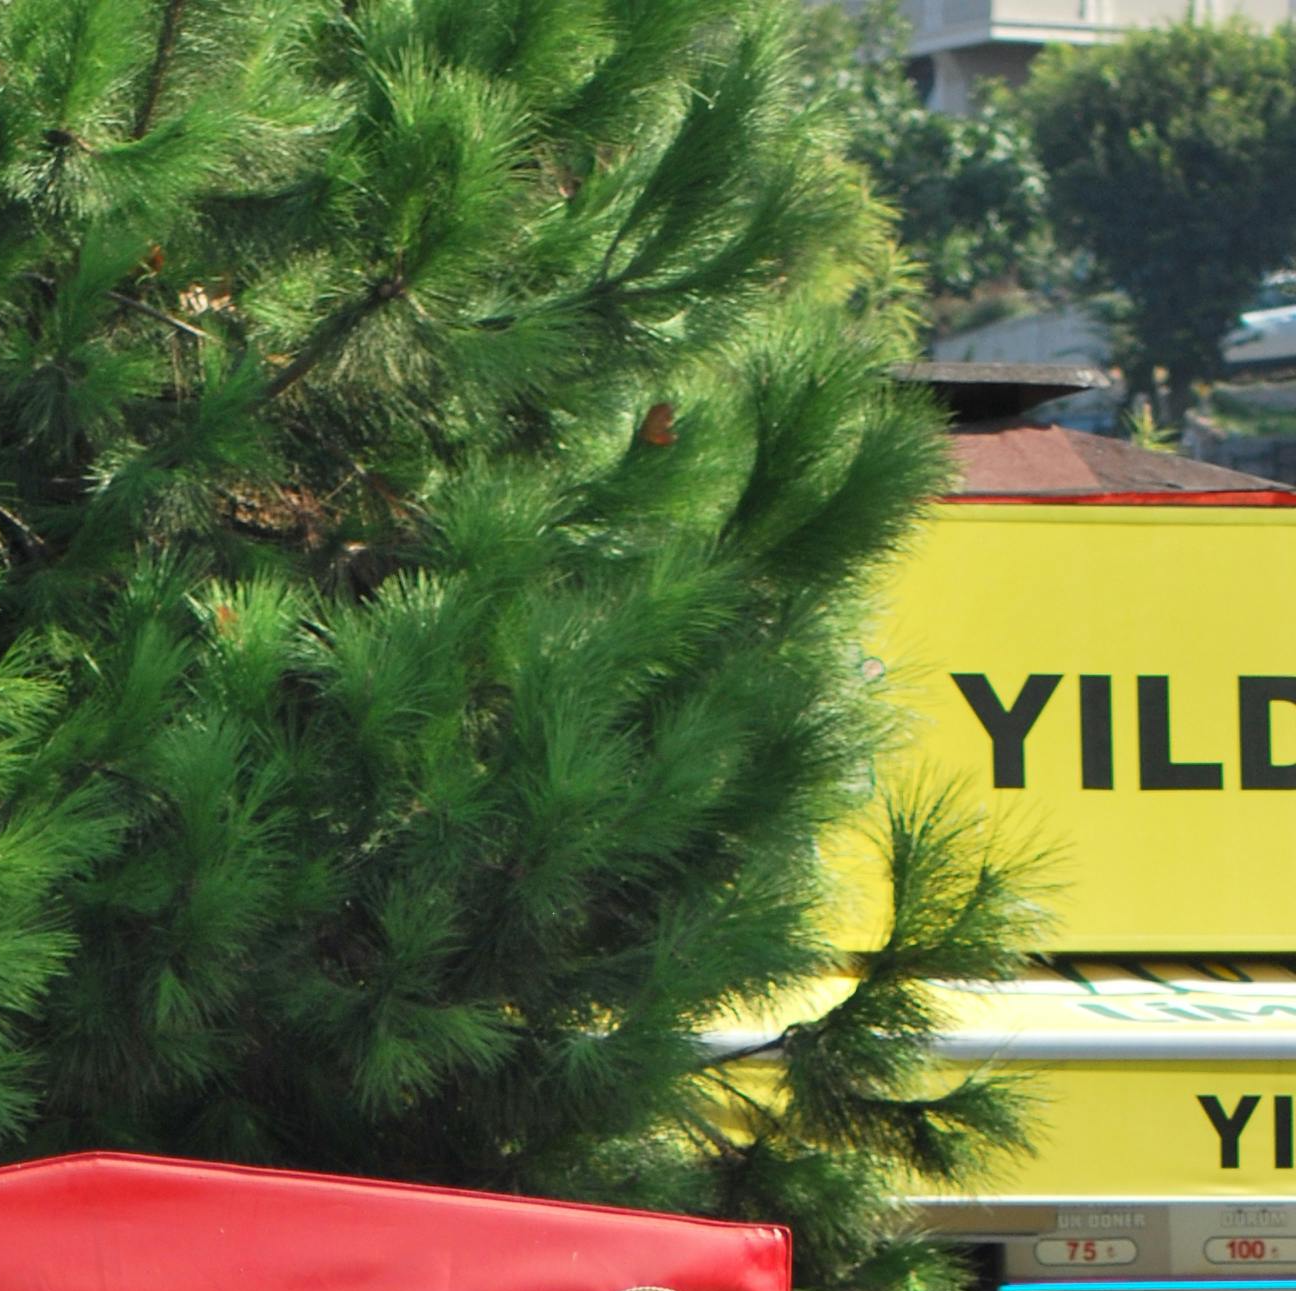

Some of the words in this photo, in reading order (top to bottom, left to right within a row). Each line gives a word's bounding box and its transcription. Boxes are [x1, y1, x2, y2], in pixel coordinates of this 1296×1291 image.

[950, 673, 1296, 790] YILD
[1197, 1095, 1294, 1169] YI
[1066, 1241, 1097, 1261] 75
[1227, 1241, 1265, 1259] 100
